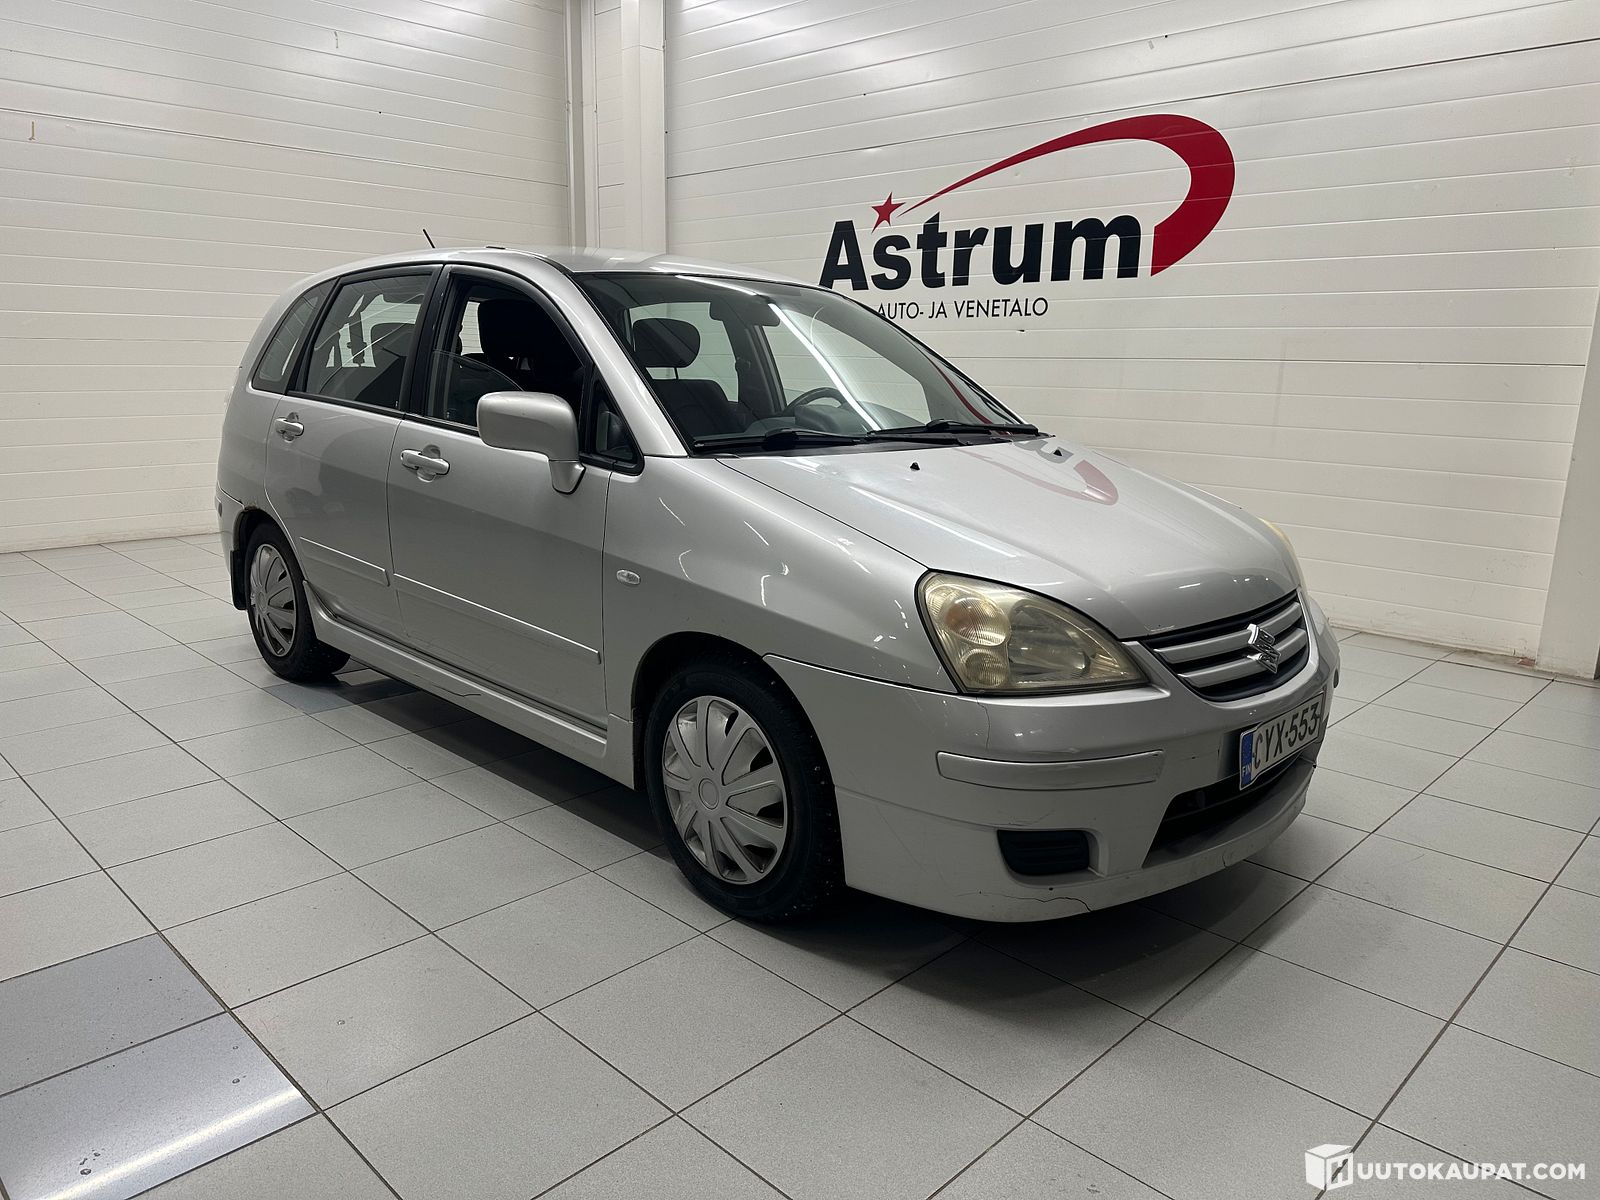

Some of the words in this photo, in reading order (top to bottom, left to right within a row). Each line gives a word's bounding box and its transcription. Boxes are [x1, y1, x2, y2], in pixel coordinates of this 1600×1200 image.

[818, 211, 1142, 291] Astrum
[877, 302, 924, 319] AUTO-
[928, 301, 948, 319] JA
[954, 297, 1049, 318] VENETALO
[1253, 701, 1320, 770] CYX-553
